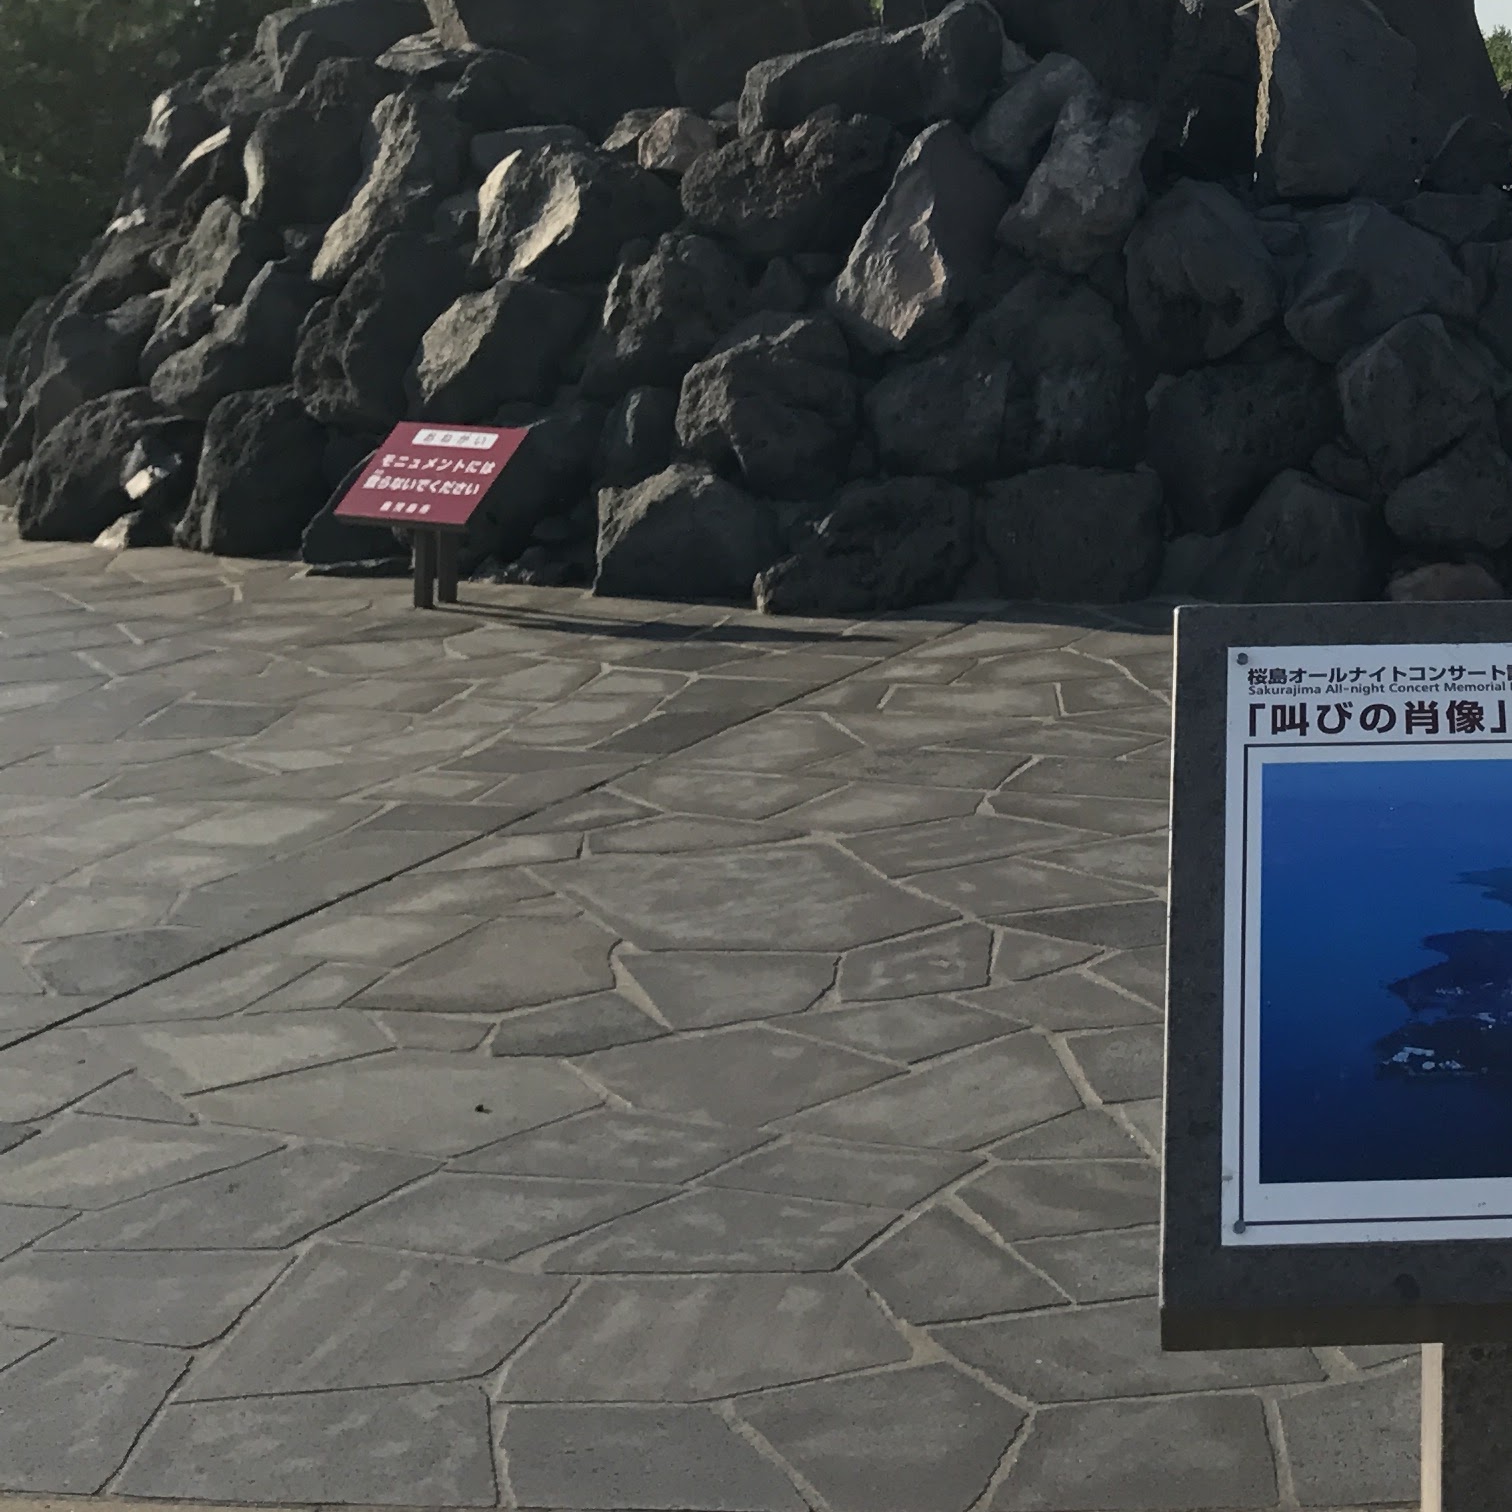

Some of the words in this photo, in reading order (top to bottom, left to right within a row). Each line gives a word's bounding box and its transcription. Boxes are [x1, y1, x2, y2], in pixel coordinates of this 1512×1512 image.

[382, 454, 496, 475] モニュメントには
[1248, 684, 1321, 696] Sakurajima
[1325, 682, 1385, 695] All-night
[1389, 682, 1440, 693] Concert
[1444, 681, 1506, 692] Memorial
